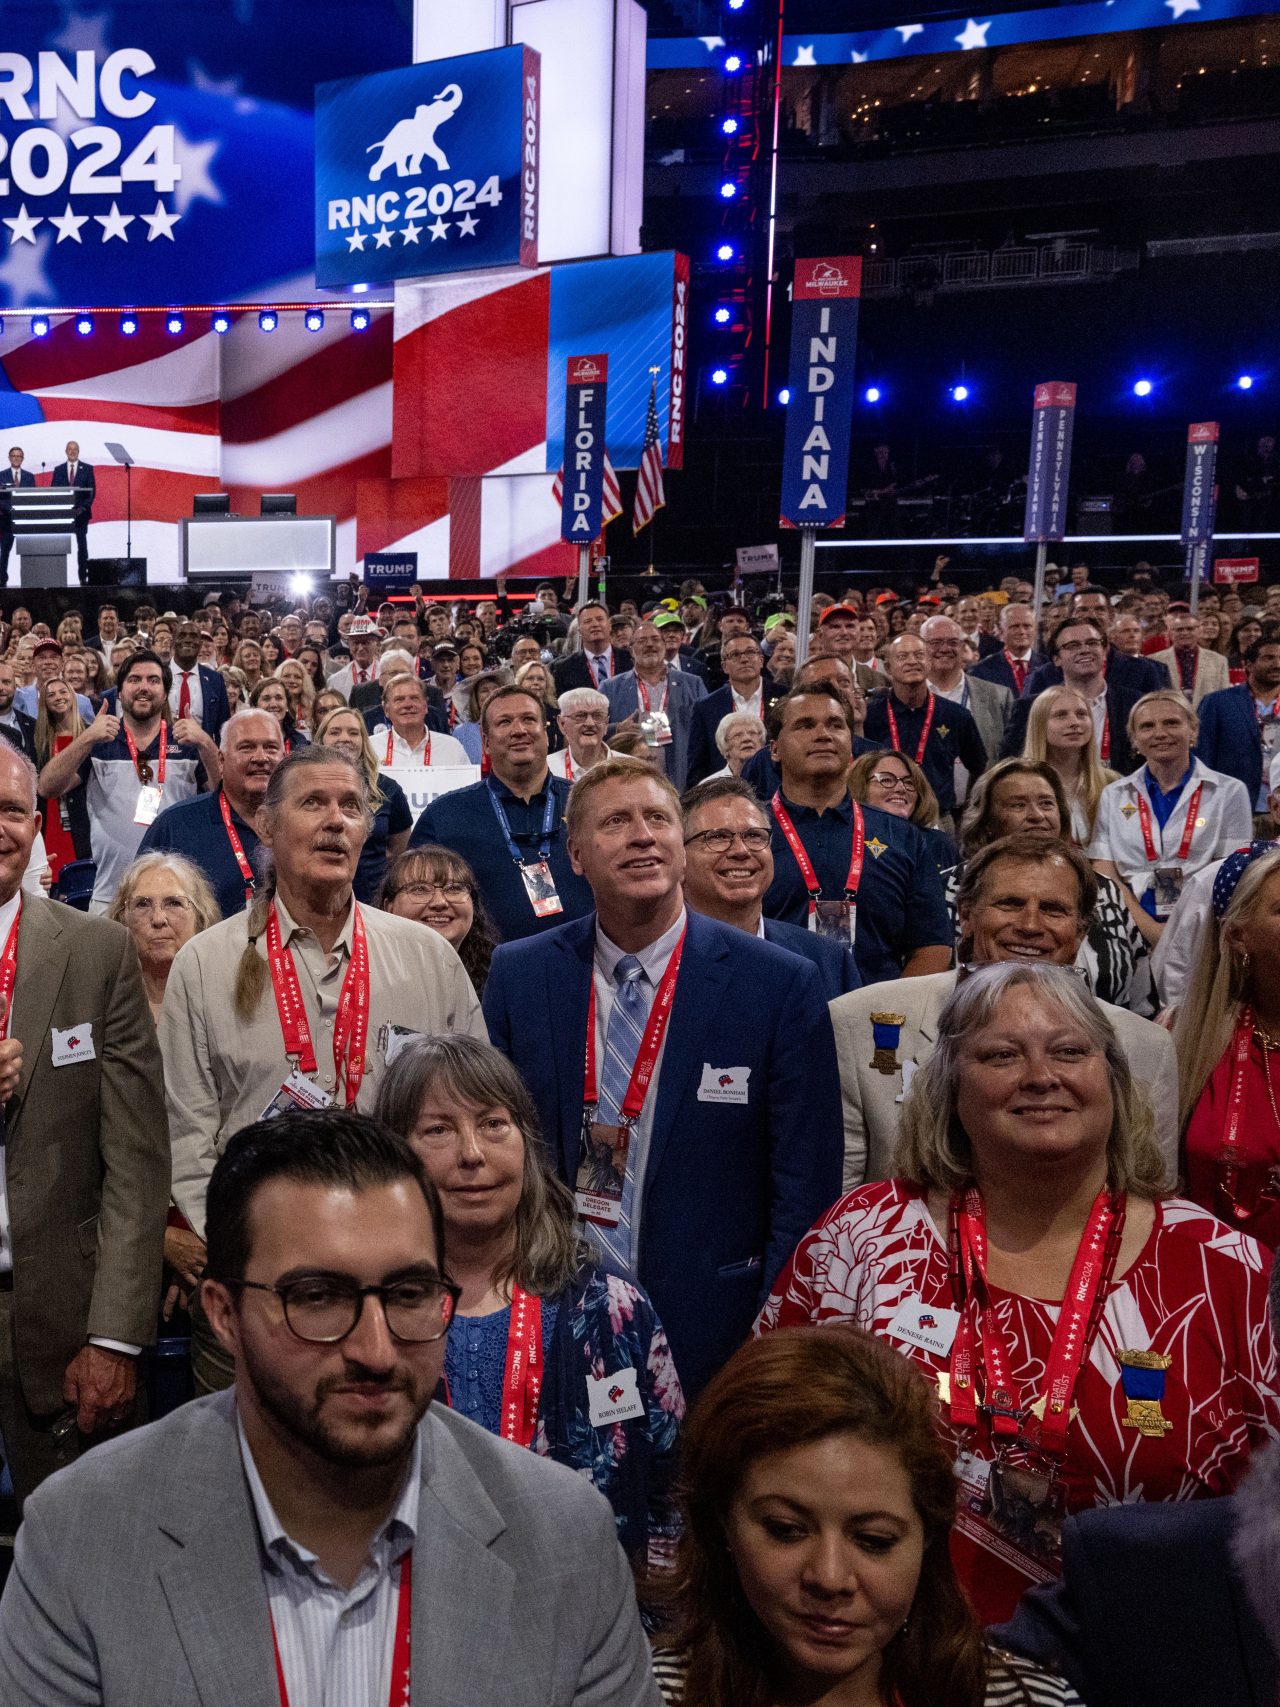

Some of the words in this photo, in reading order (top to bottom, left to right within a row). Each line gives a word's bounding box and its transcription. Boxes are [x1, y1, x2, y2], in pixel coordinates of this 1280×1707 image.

[524, 75, 537, 167] 2024
[327, 190, 400, 231] RNC
[404, 175, 503, 220] 2024
[524, 169, 536, 240] RNC
[672, 280, 686, 370] 2024
[671, 374, 684, 444] RNC
[798, 306, 838, 511] INDIANA
[571, 389, 594, 532] FLORIDA
[1030, 410, 1046, 533] PENNSYLVANIA
[1049, 409, 1067, 533] PENNSYLVANIA
[1188, 444, 1207, 538] WISCONSIN
[367, 564, 414, 574] TRUMP
[741, 553, 775, 562] TRUMP
[1218, 565, 1256, 574] TRUMP
[274, 957, 286, 985] RNC2024
[358, 979, 366, 1007] RNC2024
[661, 978, 675, 1006] RNC2024
[1228, 1112, 1239, 1141] RNC2024
[582, 1201, 611, 1212] DELEGATE
[585, 1197, 610, 1207] OREGON
[1076, 1261, 1094, 1302] RNC2024
[896, 1325, 925, 1341] DENESE
[924, 1337, 945, 1349] RAINS
[510, 1350, 522, 1390] RNC2024
[955, 1354, 963, 1375] DATA
[962, 1347, 971, 1374] TRUST
[1050, 1378, 1062, 1399] DATA
[1059, 1374, 1071, 1398] TRUST
[598, 1409, 616, 1418] ROBIN
